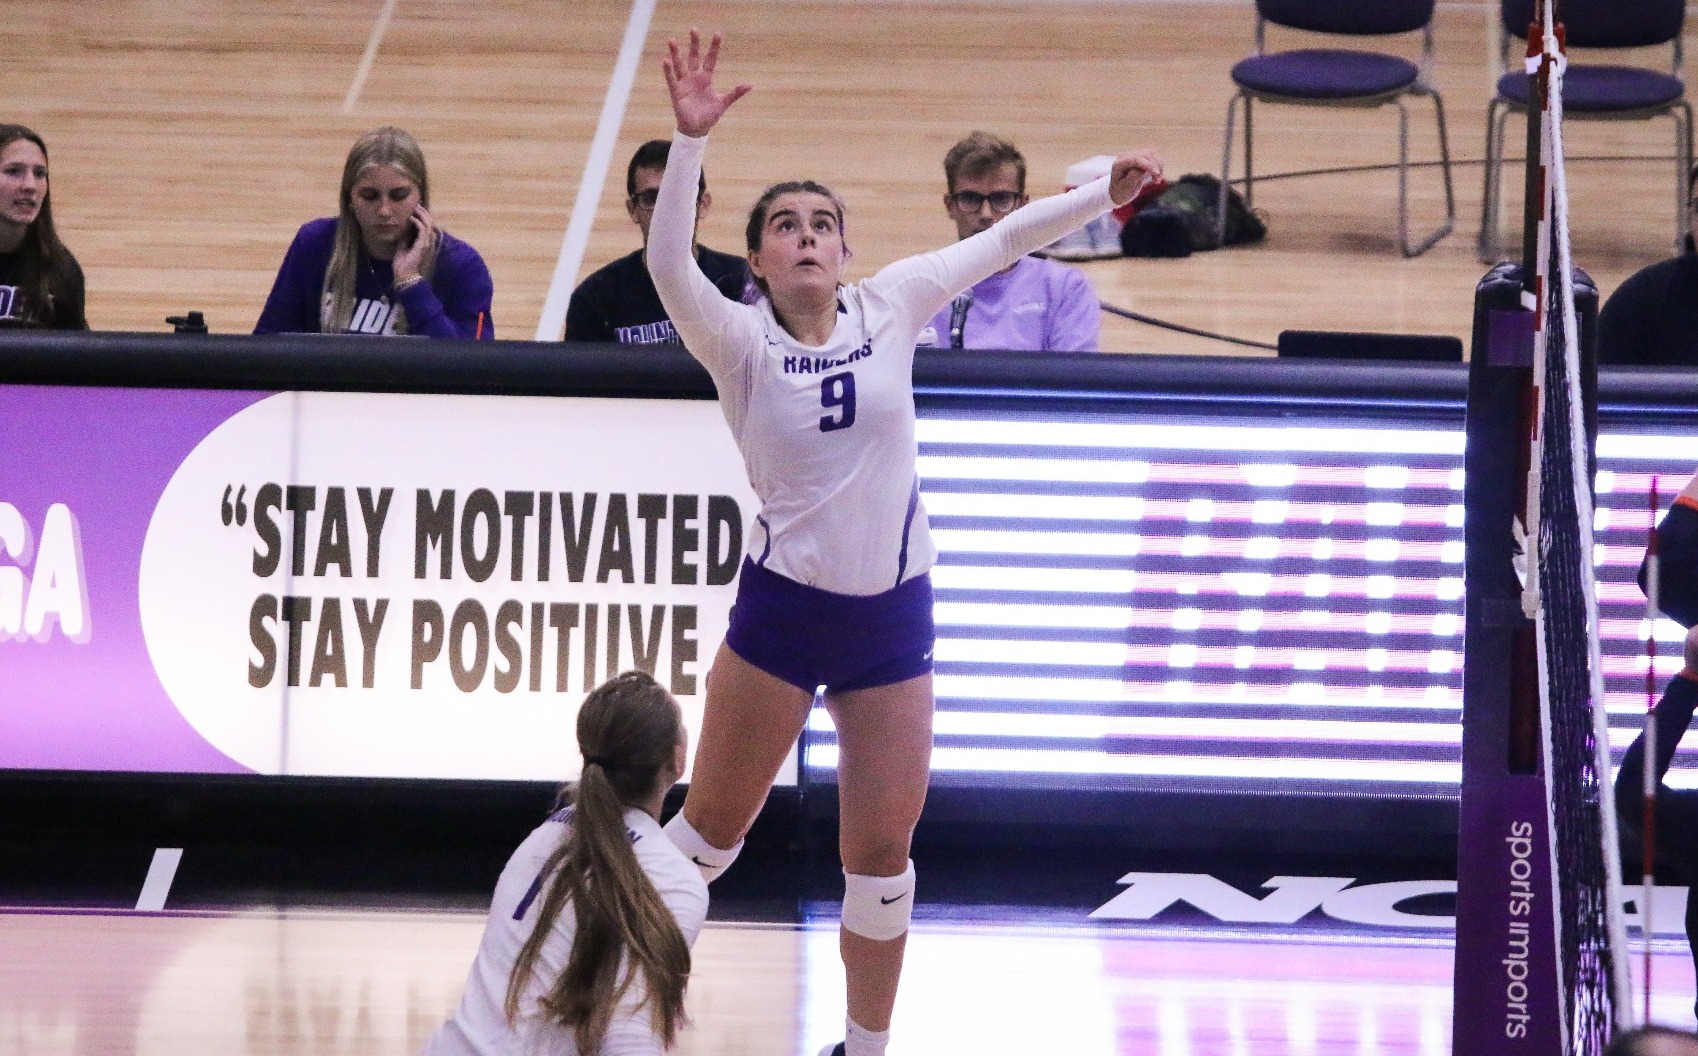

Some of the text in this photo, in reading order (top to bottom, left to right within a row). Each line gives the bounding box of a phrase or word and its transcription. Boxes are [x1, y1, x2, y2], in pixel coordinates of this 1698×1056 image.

[819, 371, 856, 433] 9
[414, 487, 743, 586] MOTIVATED
[248, 593, 737, 695] STAY POSITIIVE
[1501, 820, 1535, 1040] sports imports
